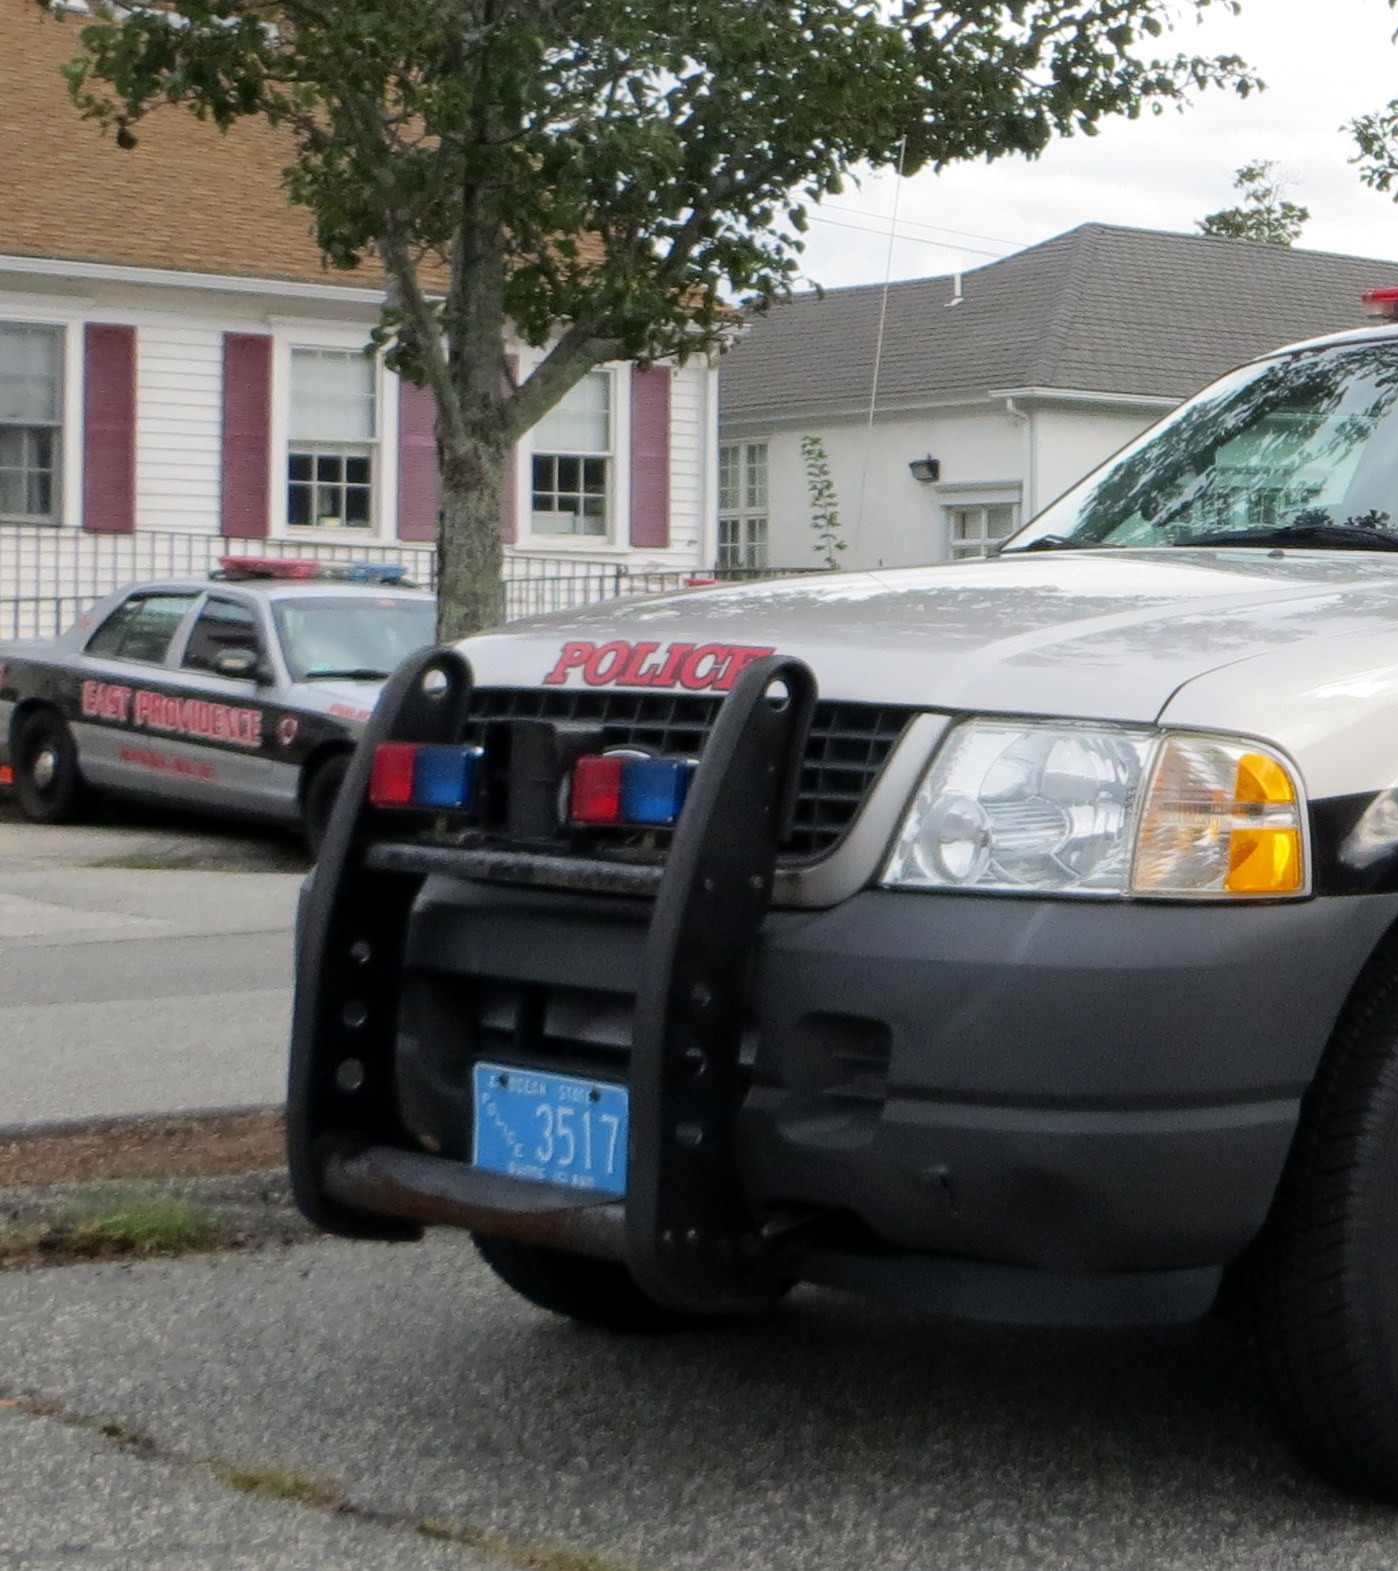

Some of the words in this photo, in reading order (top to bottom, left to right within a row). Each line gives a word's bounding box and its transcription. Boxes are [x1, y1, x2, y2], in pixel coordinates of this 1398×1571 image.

[81, 681, 133, 721] EAST
[134, 690, 263, 747] PROVIDENCE
[536, 1103, 619, 1174] 3517
